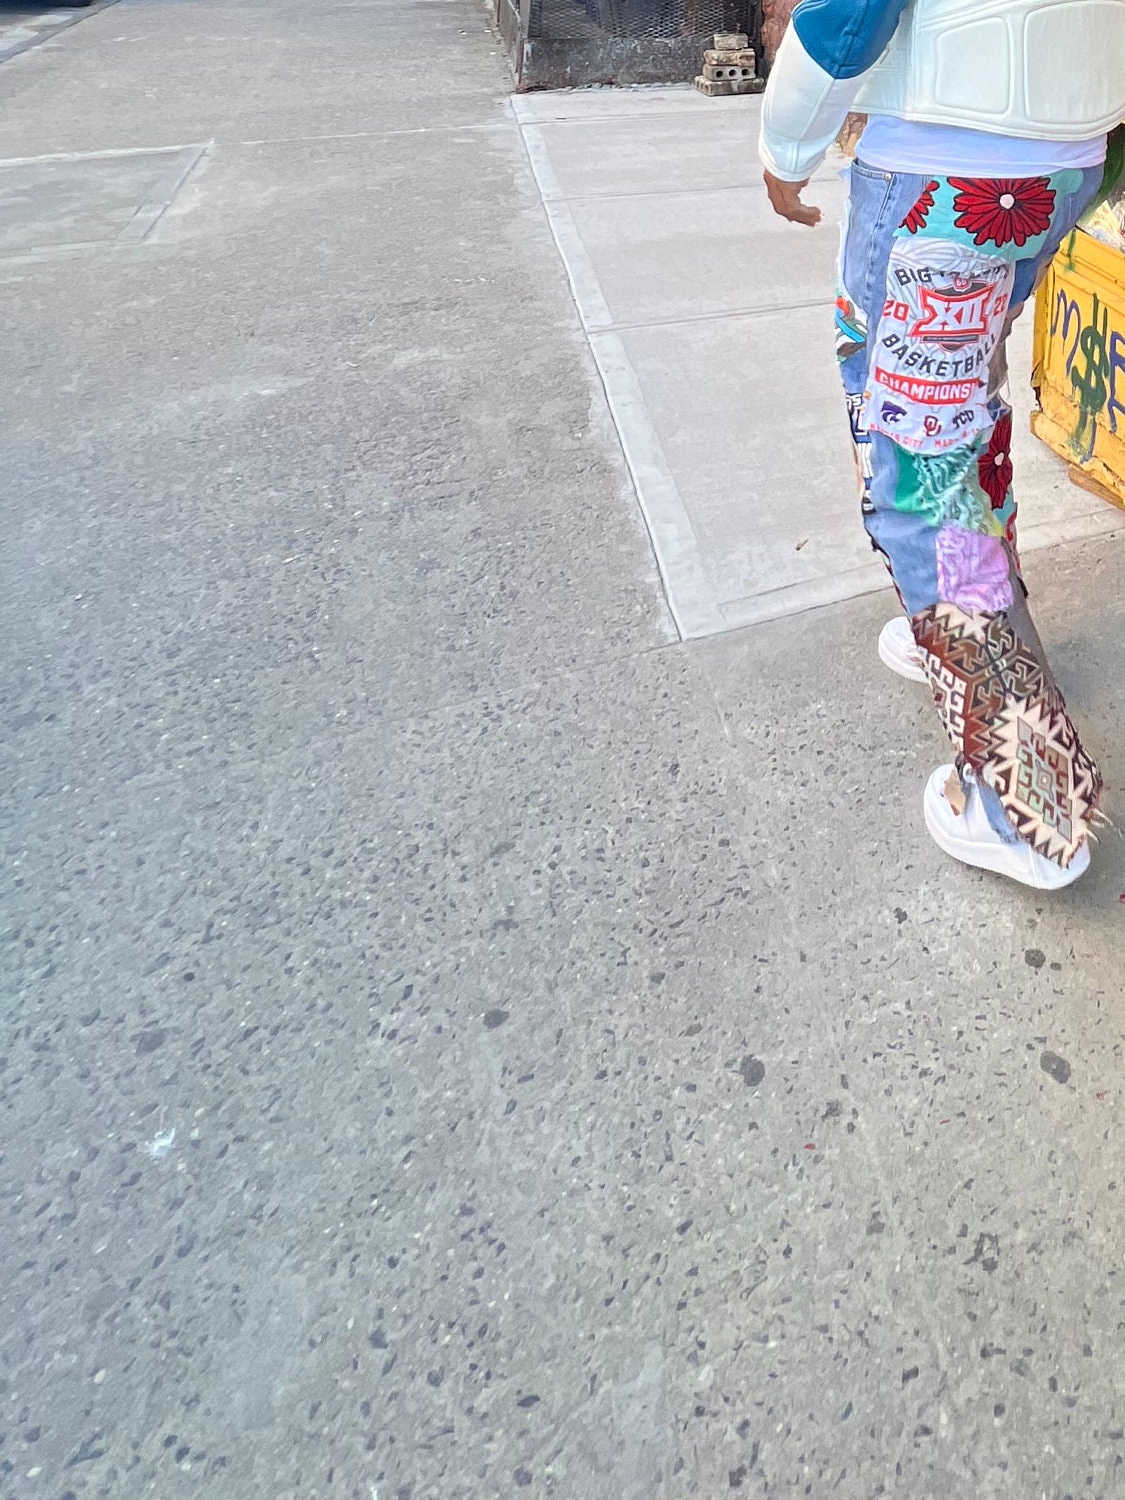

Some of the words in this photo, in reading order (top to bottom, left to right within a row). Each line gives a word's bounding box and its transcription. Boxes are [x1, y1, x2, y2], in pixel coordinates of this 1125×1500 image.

[895, 267, 932, 286] BIG
[882, 300, 909, 322] 20
[879, 373, 976, 400] CHAMPIONS
